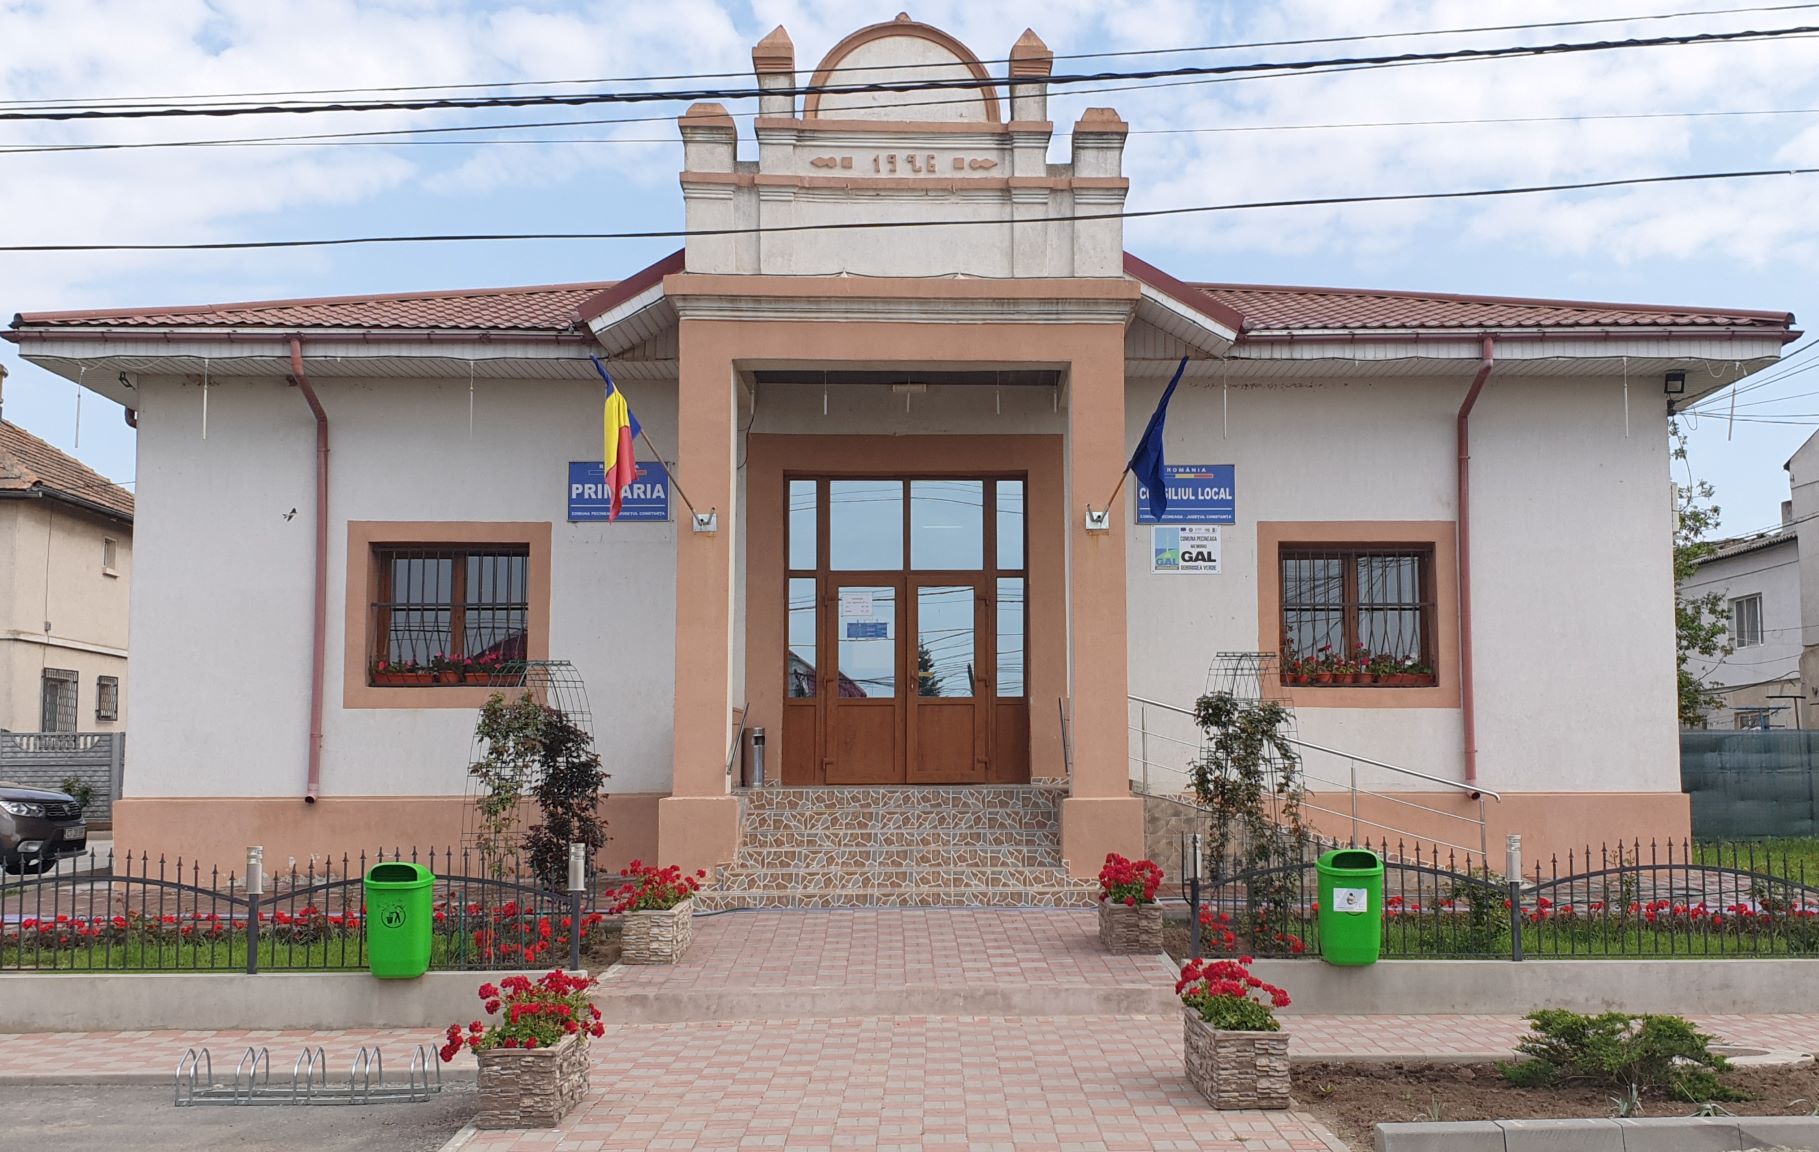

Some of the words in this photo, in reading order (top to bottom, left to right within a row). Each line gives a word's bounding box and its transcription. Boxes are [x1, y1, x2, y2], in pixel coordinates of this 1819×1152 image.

[1198, 487, 1232, 500] LOCAL
[1156, 558, 1179, 566] GAL
[1181, 550, 1217, 563] GAL
